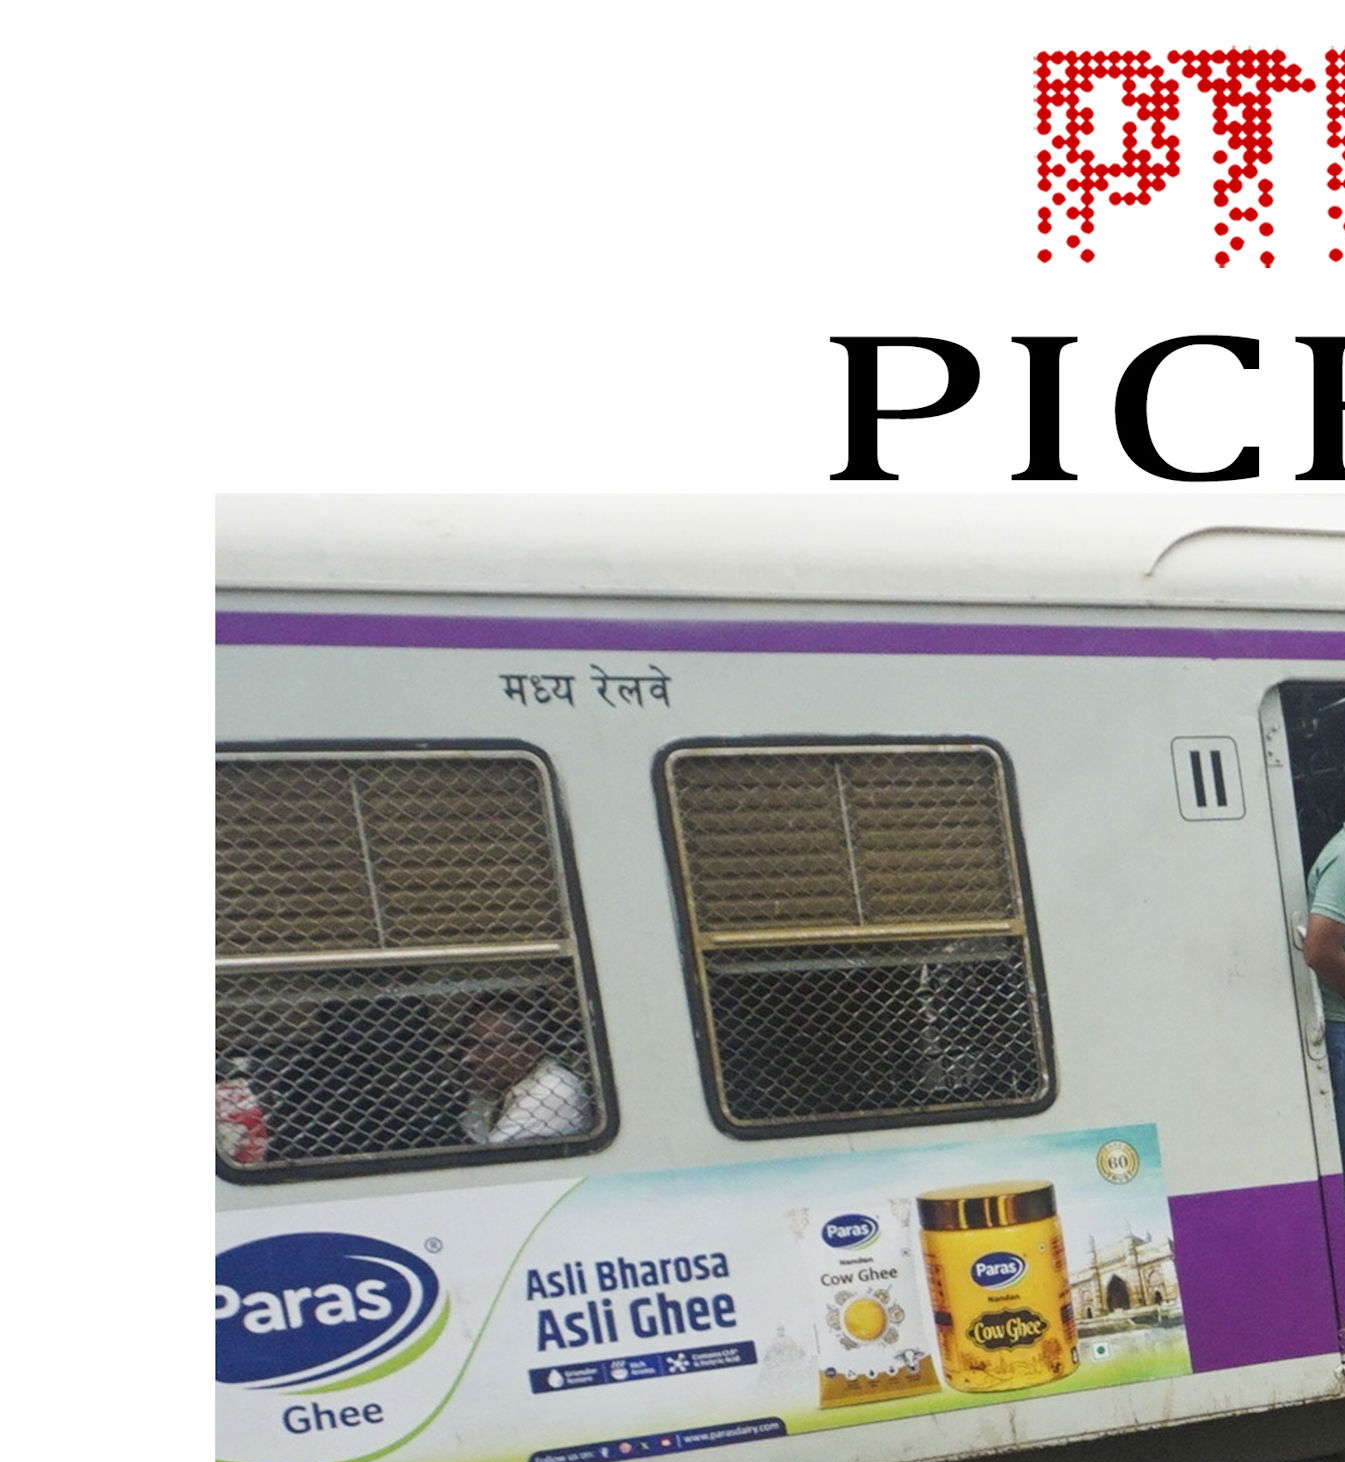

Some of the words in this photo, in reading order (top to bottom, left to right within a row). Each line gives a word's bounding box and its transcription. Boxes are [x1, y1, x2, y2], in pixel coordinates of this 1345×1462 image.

[499, 674, 576, 707] मध्य
[590, 664, 672, 708] रेलवे
[827, 1223, 870, 1239] Paras
[526, 1267, 586, 1301] Asli
[598, 1251, 730, 1293] Bharosa
[820, 1273, 853, 1287] Cow
[858, 1267, 898, 1282] Ghee
[975, 1262, 1018, 1278] Paras
[536, 1301, 617, 1352] Asli
[631, 1292, 737, 1340] Ghee
[973, 1322, 1005, 1344] Cow
[1006, 1317, 1042, 1343] Ghee
[282, 1399, 384, 1434] Ghee
[683, 1421, 780, 1444] www.parasdairy.com
